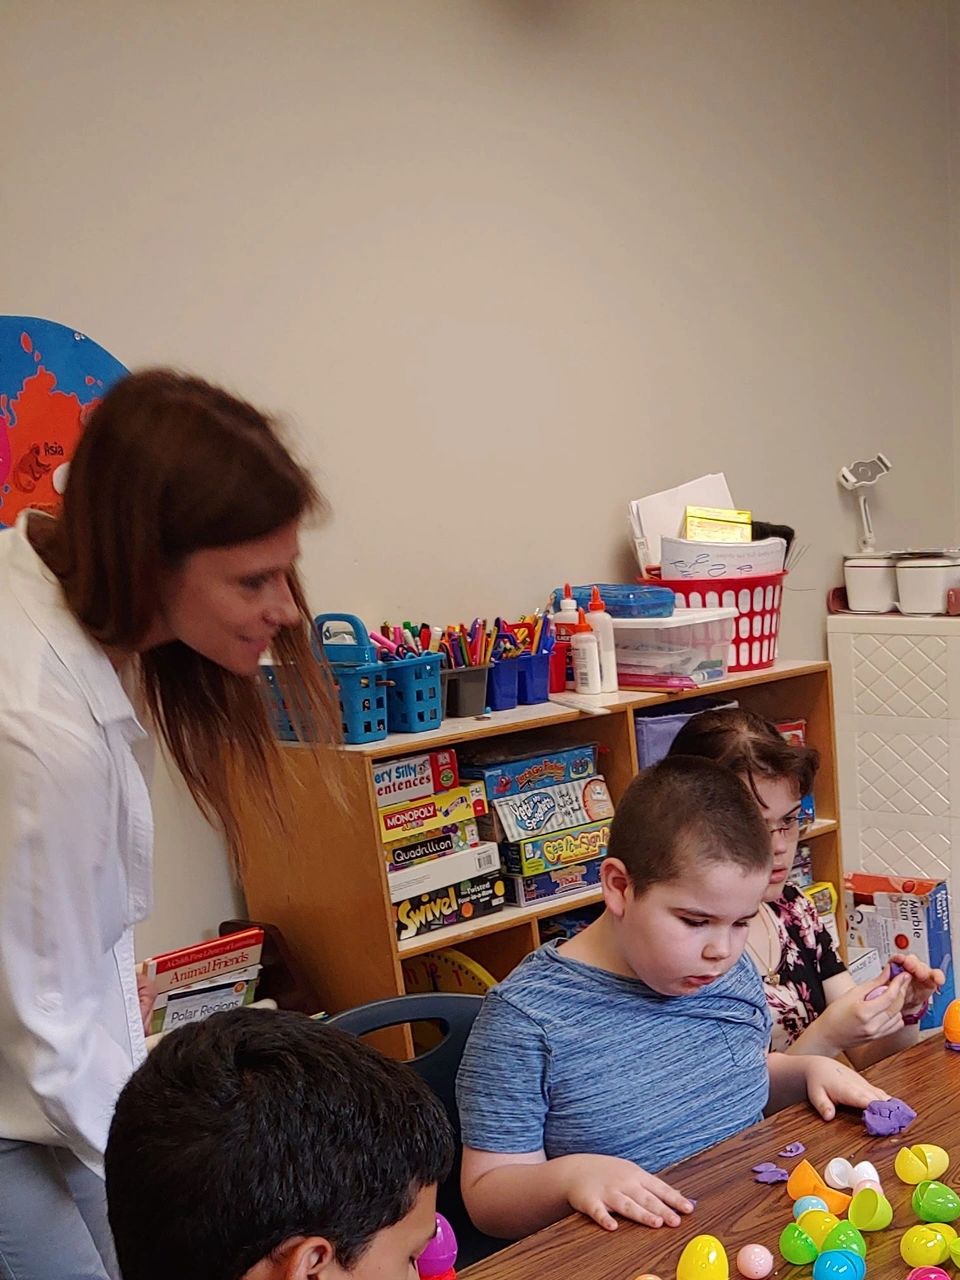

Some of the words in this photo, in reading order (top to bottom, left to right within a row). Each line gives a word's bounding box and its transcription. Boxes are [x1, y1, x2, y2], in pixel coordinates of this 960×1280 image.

[44, 442, 64, 456] Asia
[374, 767, 392, 784] ery
[395, 763, 417, 779] Silly
[377, 774, 431, 796] entences
[386, 805, 435, 828] MONOPOLY
[510, 800, 532, 821] Yeti
[394, 839, 452, 862] Quadrillion
[544, 838, 564, 860] See
[579, 831, 601, 851] Sign
[398, 886, 458, 940] Swivel
[899, 899, 909, 921] Run
[909, 899, 923, 939] Marble
[170, 961, 210, 984] Animal
[210, 952, 249, 971] Friends
[171, 1008, 199, 1023] Polar
